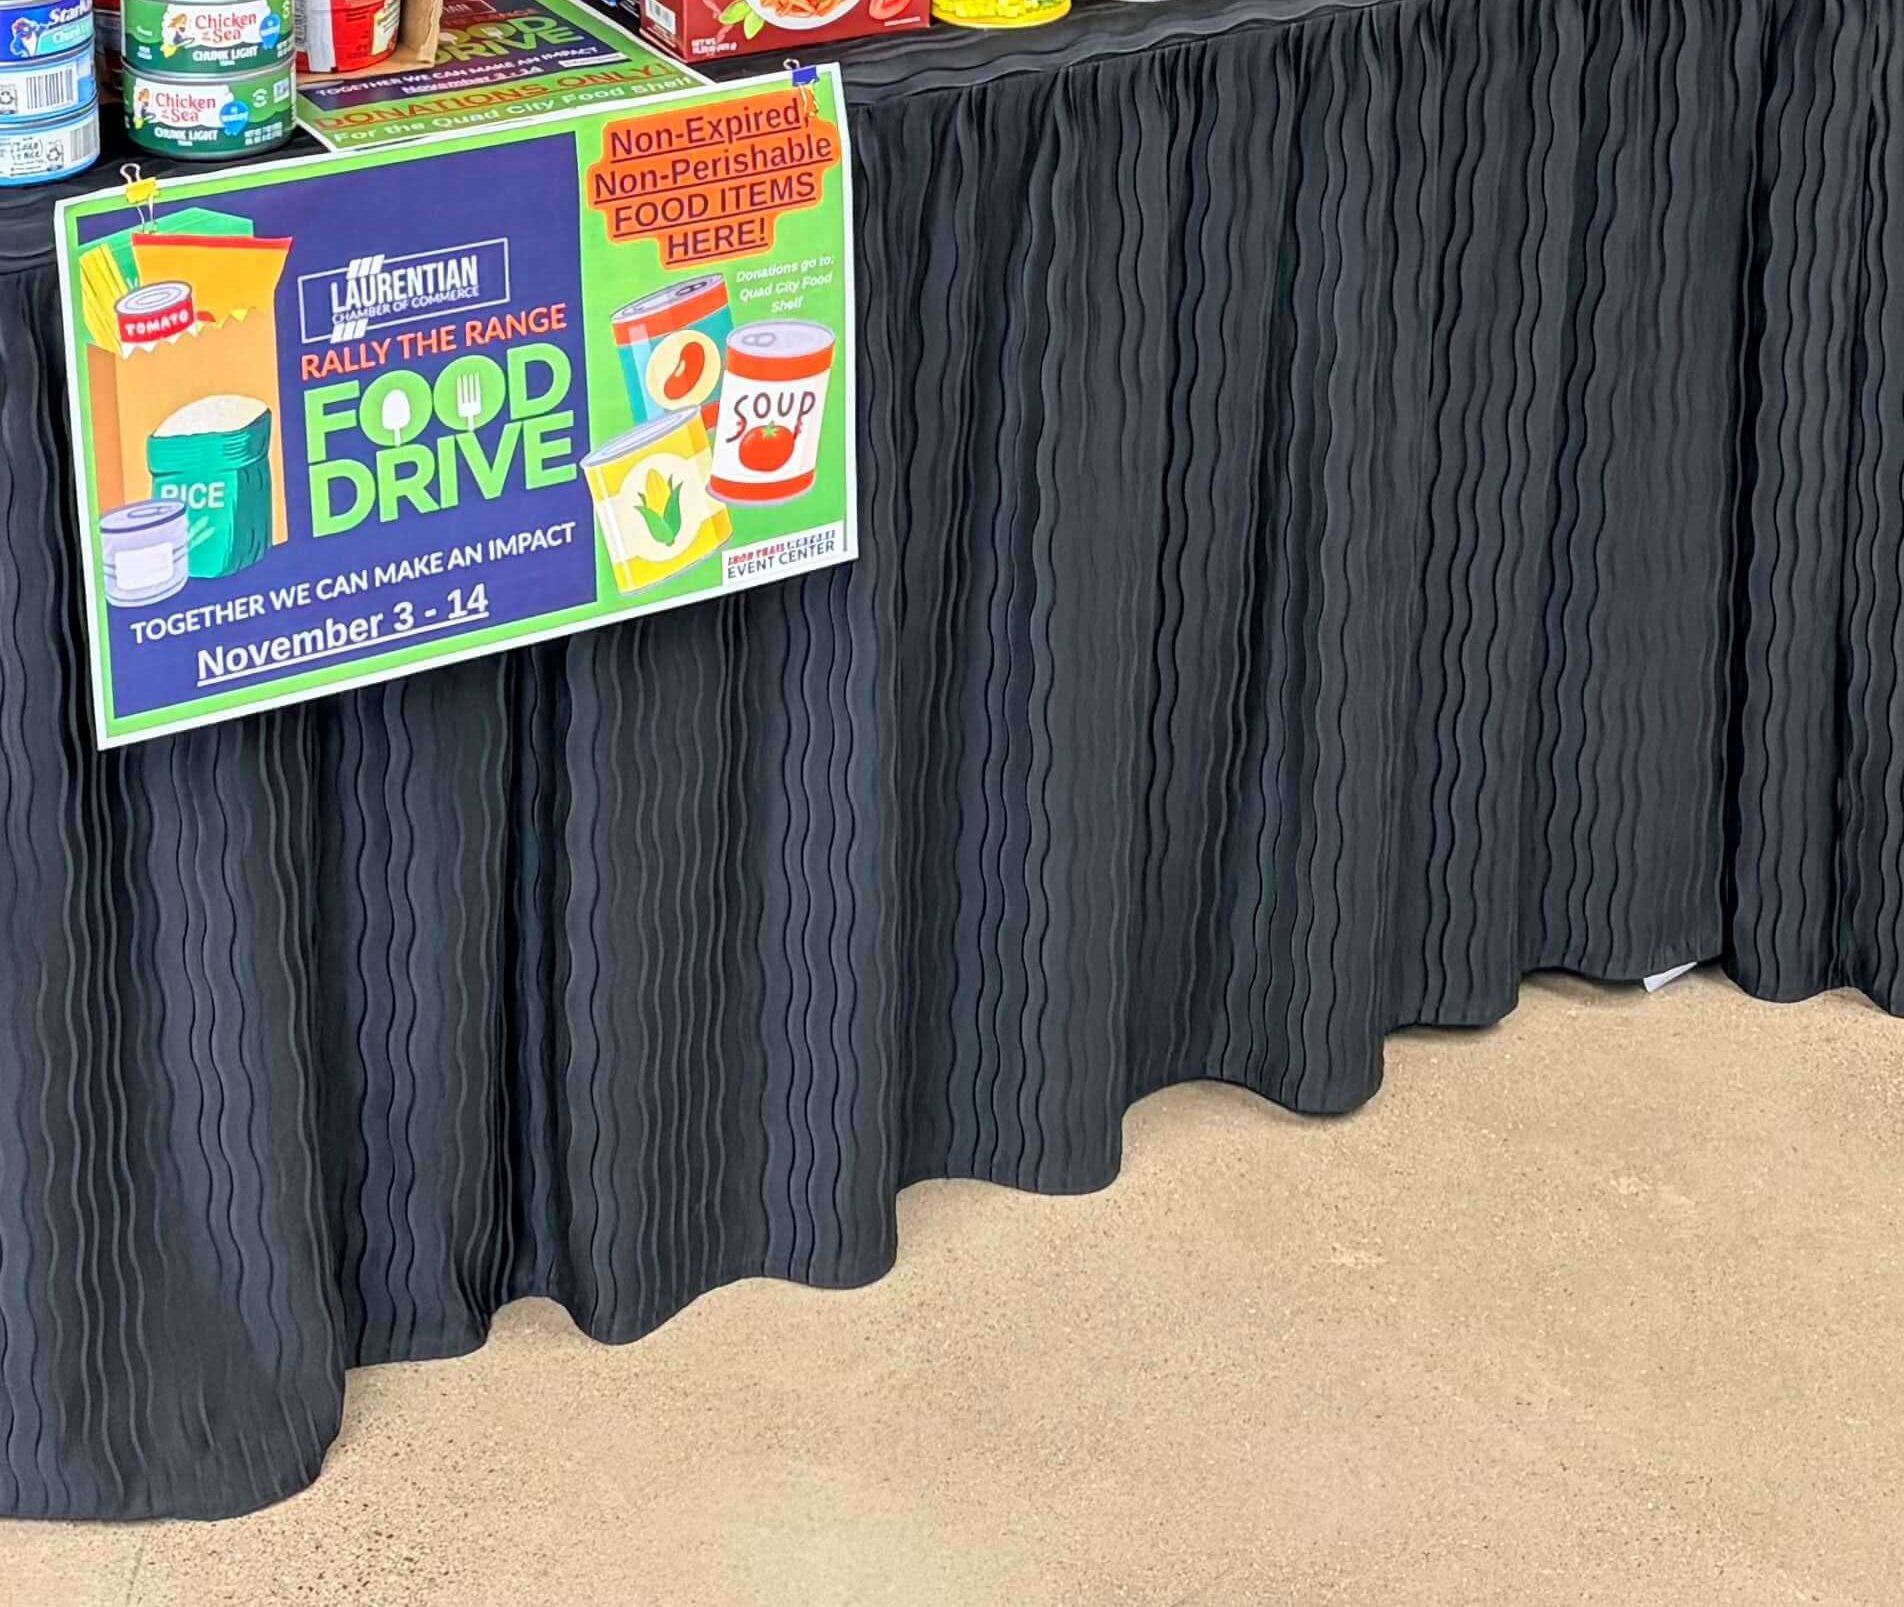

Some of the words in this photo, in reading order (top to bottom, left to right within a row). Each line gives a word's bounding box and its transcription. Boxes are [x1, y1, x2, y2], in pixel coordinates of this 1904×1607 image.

[195, 10, 258, 32] Chicken
[212, 26, 242, 41] Sea
[231, 46, 258, 60] LIGHT
[611, 98, 810, 158] Non-Expired,
[594, 134, 832, 199] Non-Perishable
[615, 193, 709, 232] FOOD
[720, 172, 815, 212] ITEMS
[668, 218, 766, 259] HERE!
[330, 255, 478, 314] LAURENTIAN
[736, 263, 798, 282] Donations
[800, 260, 817, 273] go
[819, 256, 834, 268] to:
[740, 283, 772, 302] Quad
[775, 281, 800, 295] City
[802, 274, 832, 288] Food
[125, 308, 191, 335] TOMATO
[332, 302, 390, 325] CHAMBER
[393, 299, 409, 312] OF
[411, 286, 480, 310] COMMERCE
[771, 297, 804, 313] Shelf
[301, 338, 392, 380] RALLY
[397, 325, 457, 359] THE
[466, 304, 568, 346] RANGE
[304, 343, 572, 463] FOOD
[726, 391, 816, 443] SOUP
[308, 410, 578, 538] DRIVE
[728, 557, 774, 579] EVENT
[779, 540, 835, 566] CENTER
[130, 588, 265, 644] TOGETHER
[269, 583, 311, 608] WE
[316, 570, 368, 598] CAN
[374, 553, 444, 584] MAKE
[448, 546, 483, 571] AN
[487, 522, 576, 561] IMPACT
[197, 614, 384, 681] November
[393, 601, 414, 629] 3
[447, 583, 488, 618] 14
